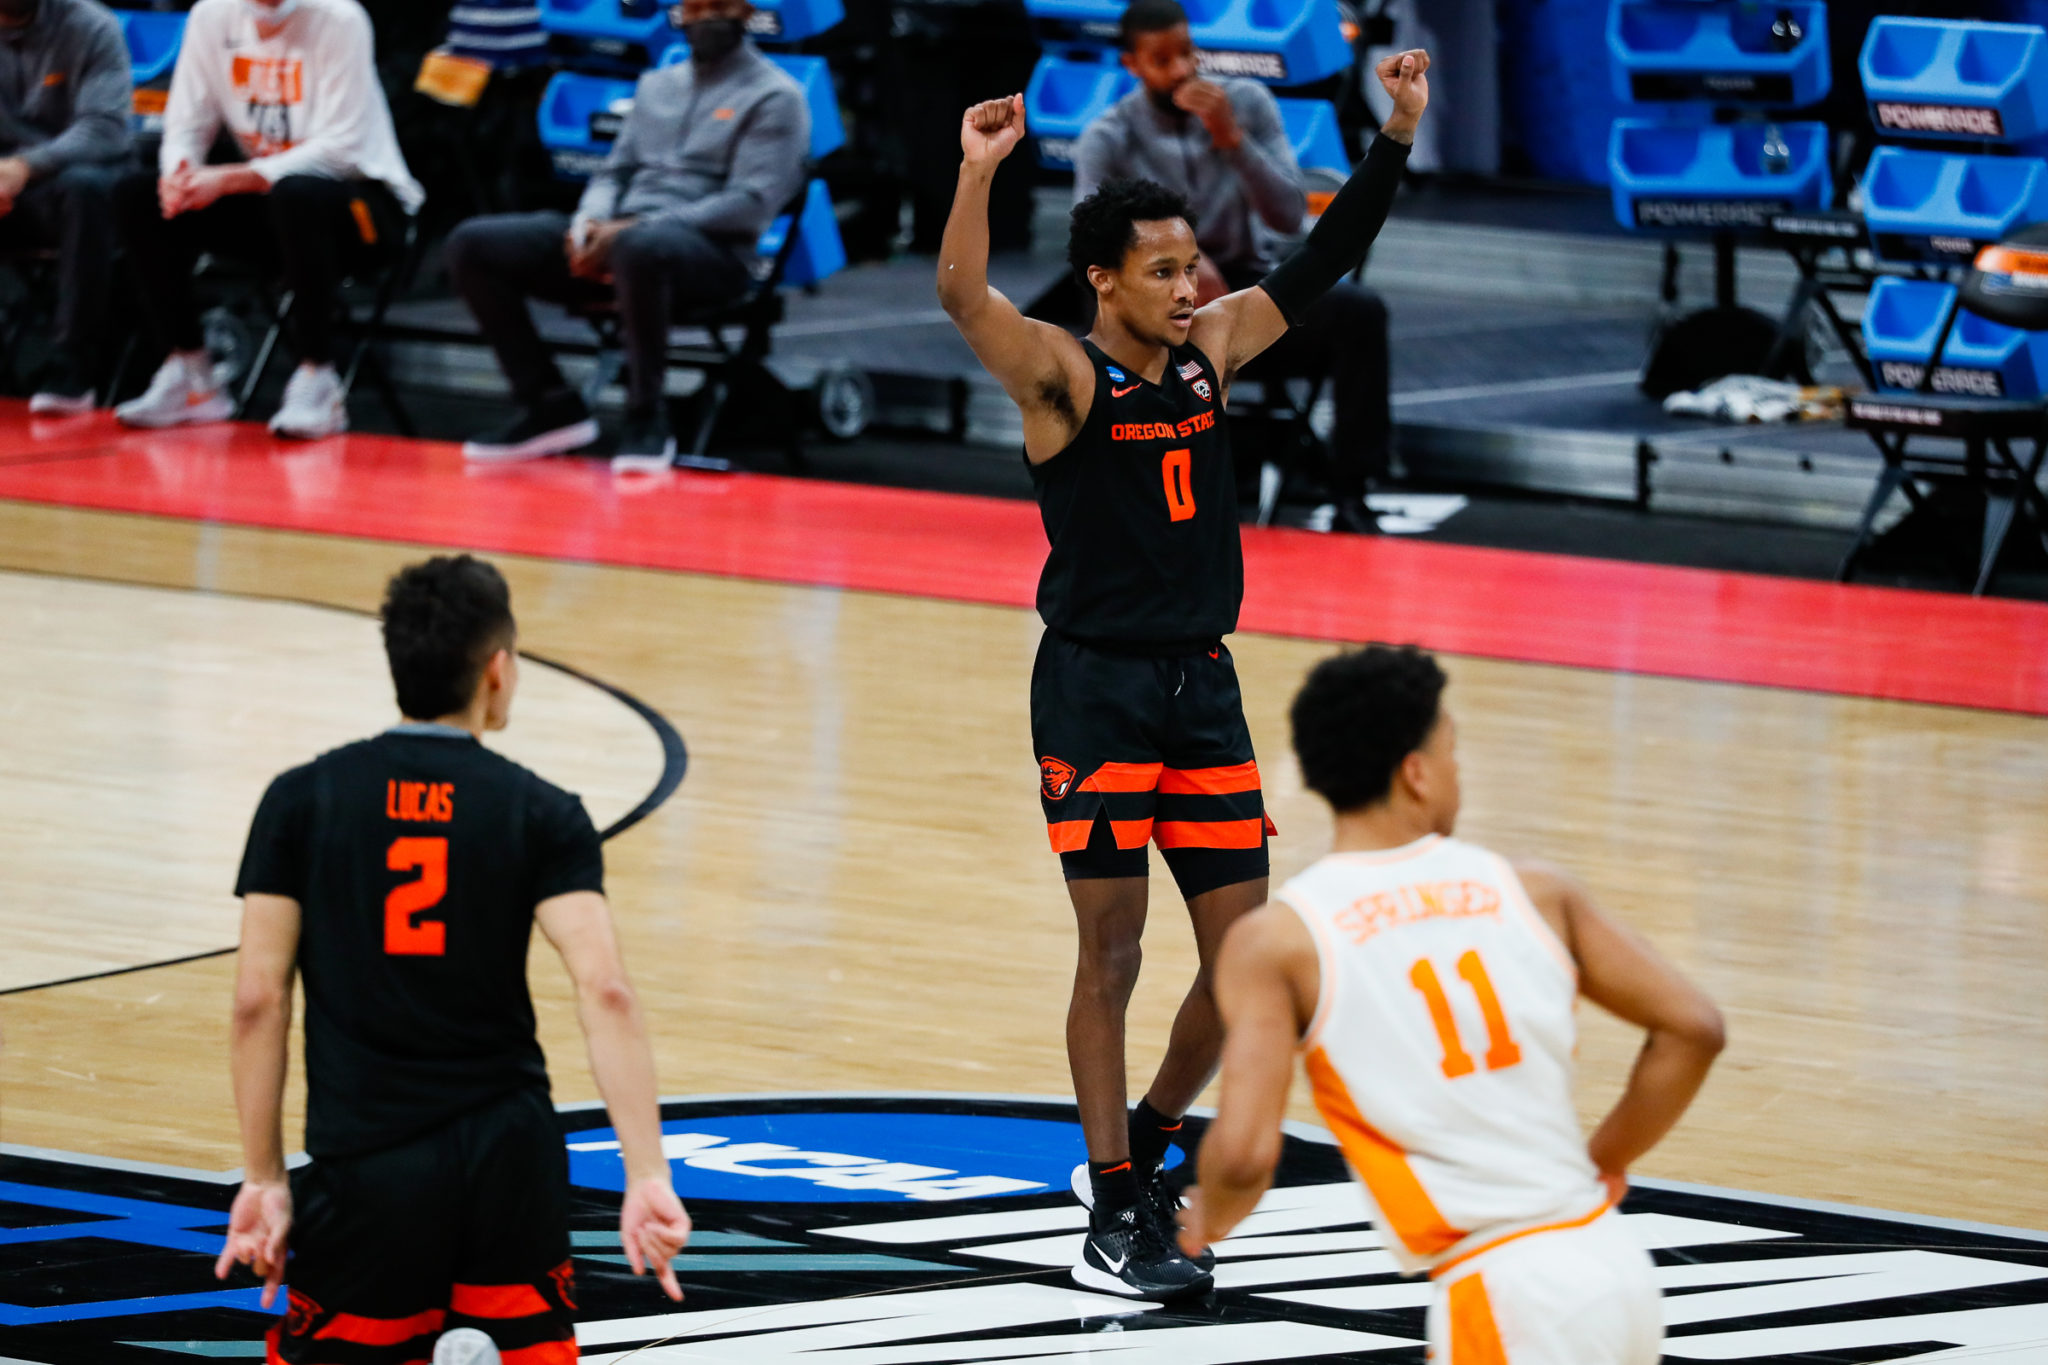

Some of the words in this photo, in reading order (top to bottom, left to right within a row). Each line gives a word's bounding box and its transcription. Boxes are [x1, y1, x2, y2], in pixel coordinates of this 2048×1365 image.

[1111, 422, 1177, 441] OREGON
[1161, 448, 1197, 522] 0
[386, 779, 455, 823] LUCAS
[384, 836, 449, 956] 2
[1333, 878, 1504, 946] SPRINGER
[1408, 948, 1522, 1080] 11
[565, 1132, 1049, 1201] NCAA
